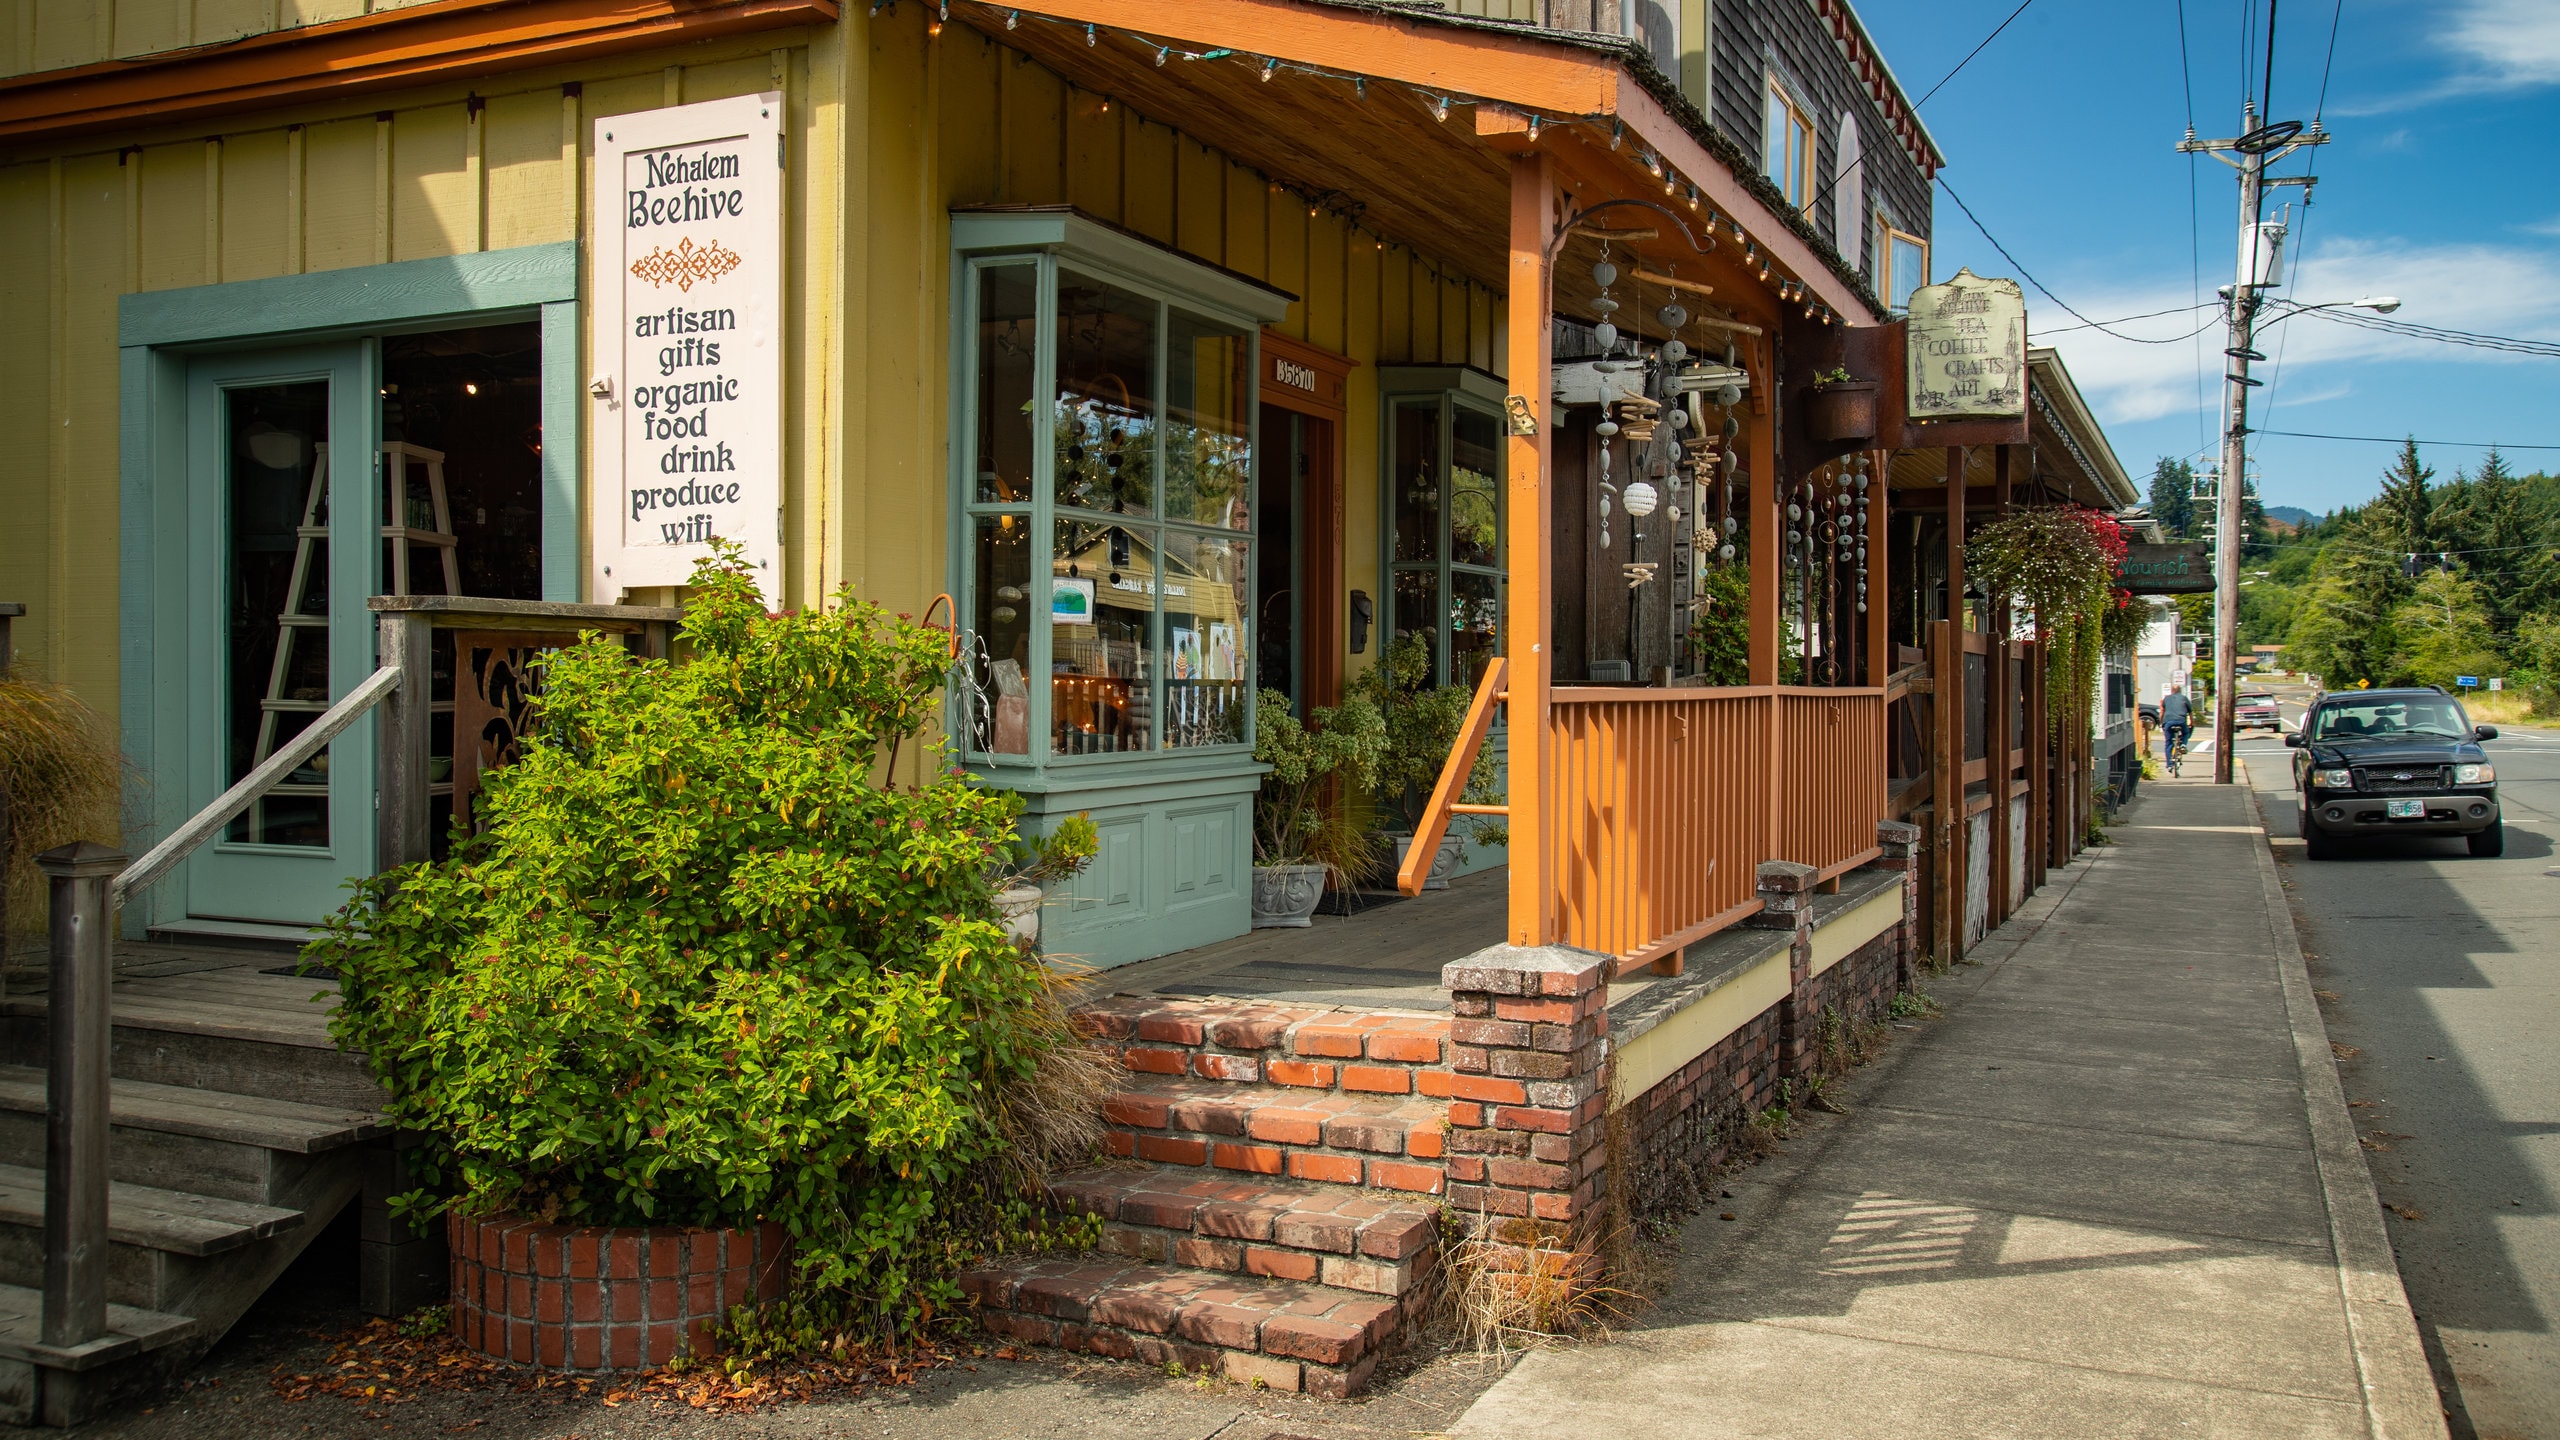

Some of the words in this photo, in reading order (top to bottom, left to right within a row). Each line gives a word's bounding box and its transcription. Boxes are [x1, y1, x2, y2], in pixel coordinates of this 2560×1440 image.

[644, 151, 740, 188] Nehalem
[627, 186, 743, 228] Beehive
[635, 307, 736, 337] artisan
[1957, 317, 1987, 334] TEA
[659, 338, 721, 376] gifts
[1944, 357, 2005, 378] CRAFTS
[1279, 360, 1314, 392] 35870
[1949, 380, 1981, 398] ART
[634, 374, 740, 414] organic
[644, 408, 707, 440] food
[661, 441, 736, 474] drink
[631, 477, 741, 522] produce
[660, 514, 714, 544] wifi
[2117, 554, 2189, 575] Nourish
